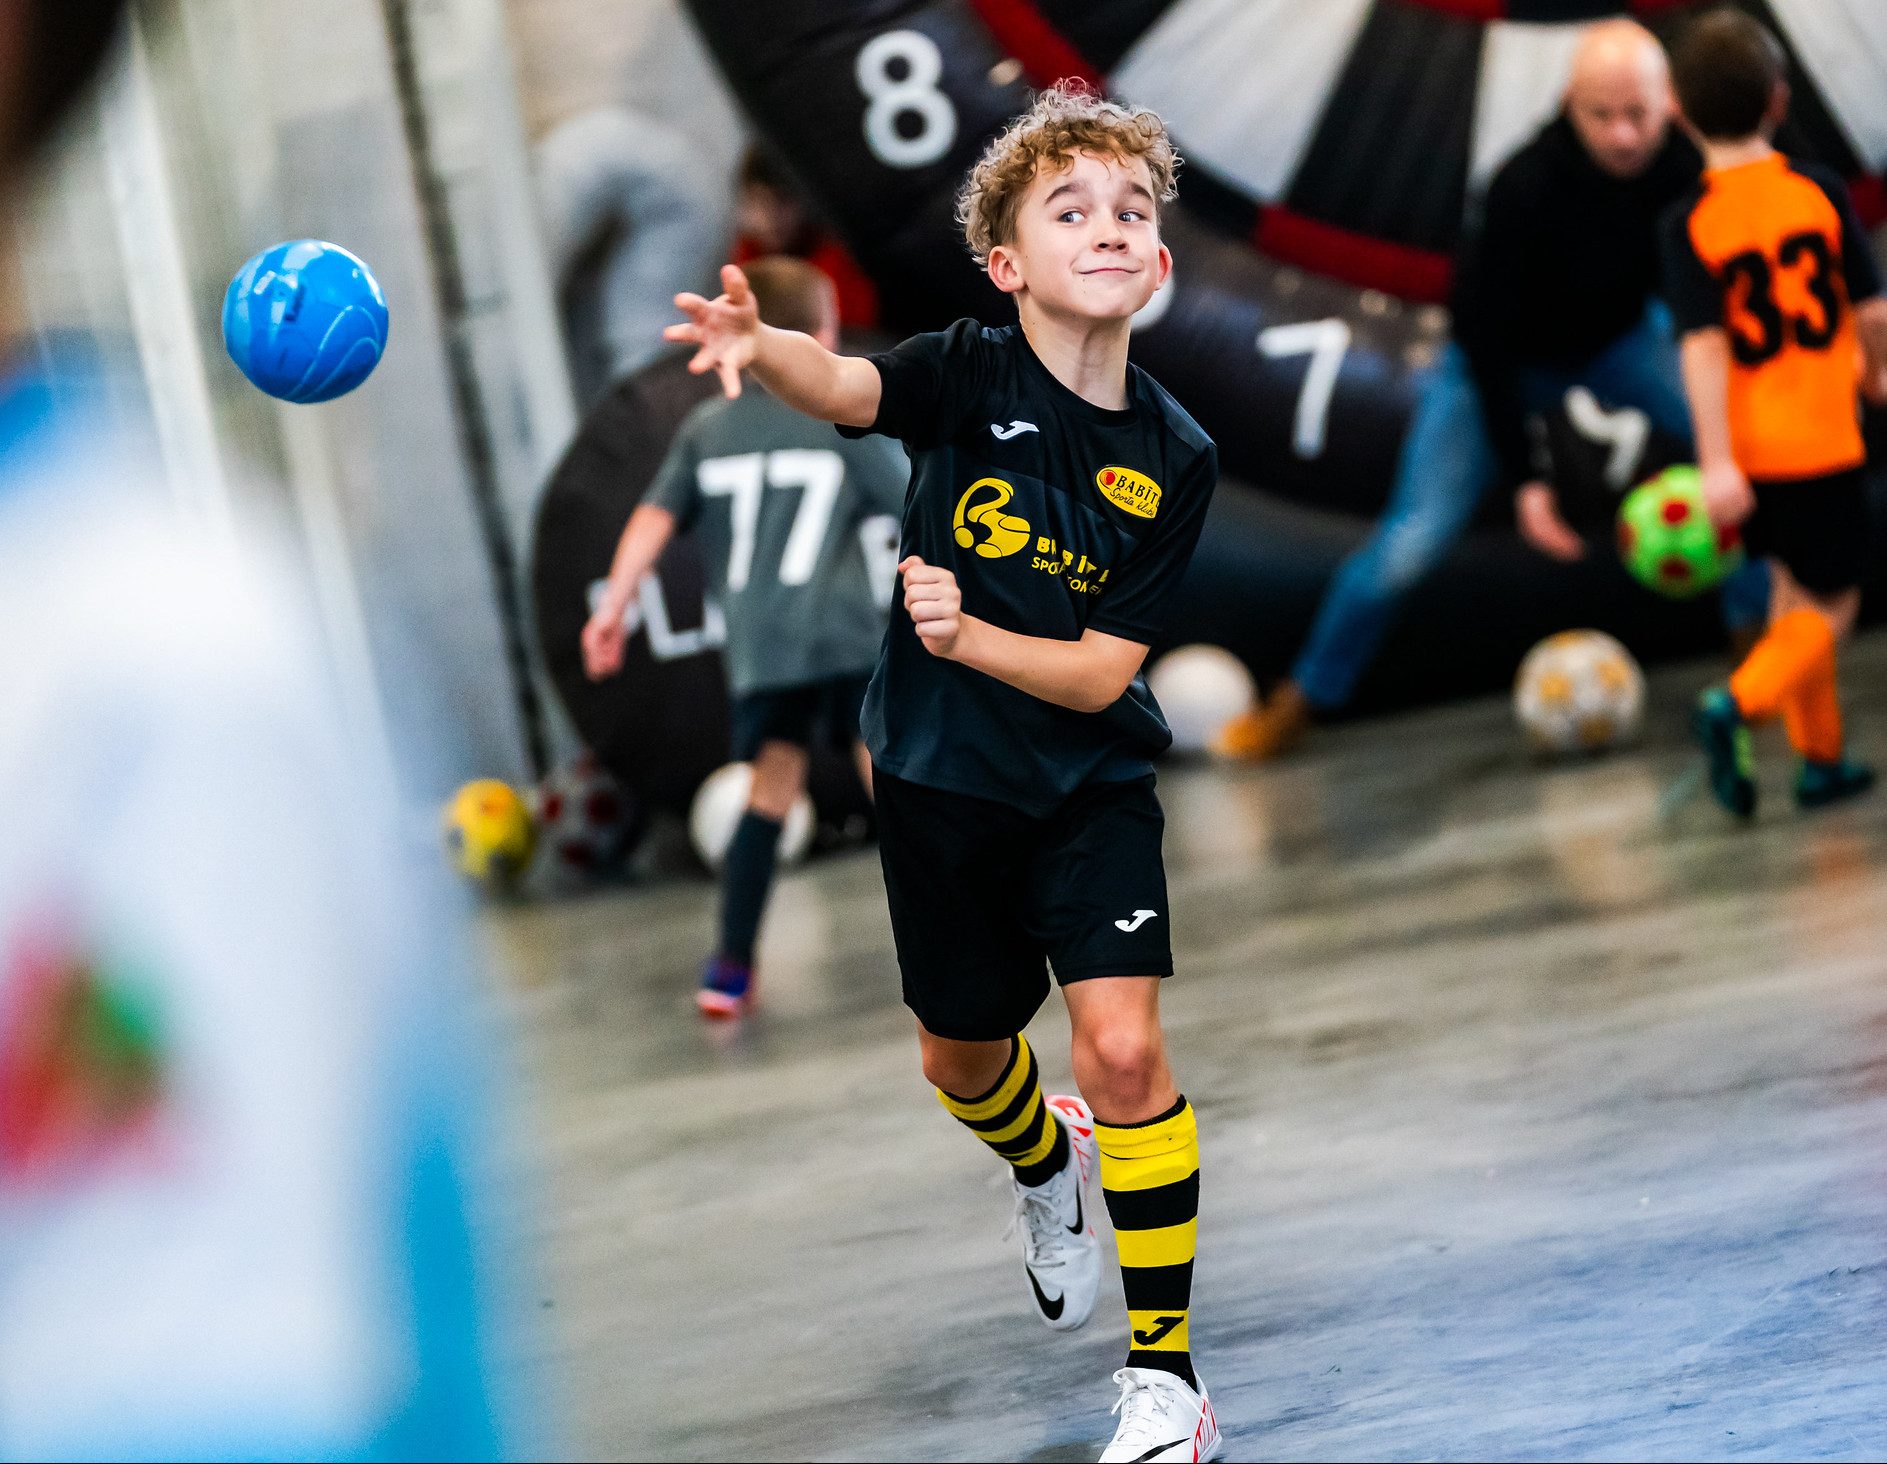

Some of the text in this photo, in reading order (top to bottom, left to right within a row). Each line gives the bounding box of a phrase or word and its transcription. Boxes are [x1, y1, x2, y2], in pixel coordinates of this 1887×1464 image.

[855, 29, 958, 169] 8
[1721, 230, 1842, 365] 33
[1256, 317, 1351, 460] 7
[697, 447, 846, 593] 77
[1116, 475, 1159, 508] BABĪT
